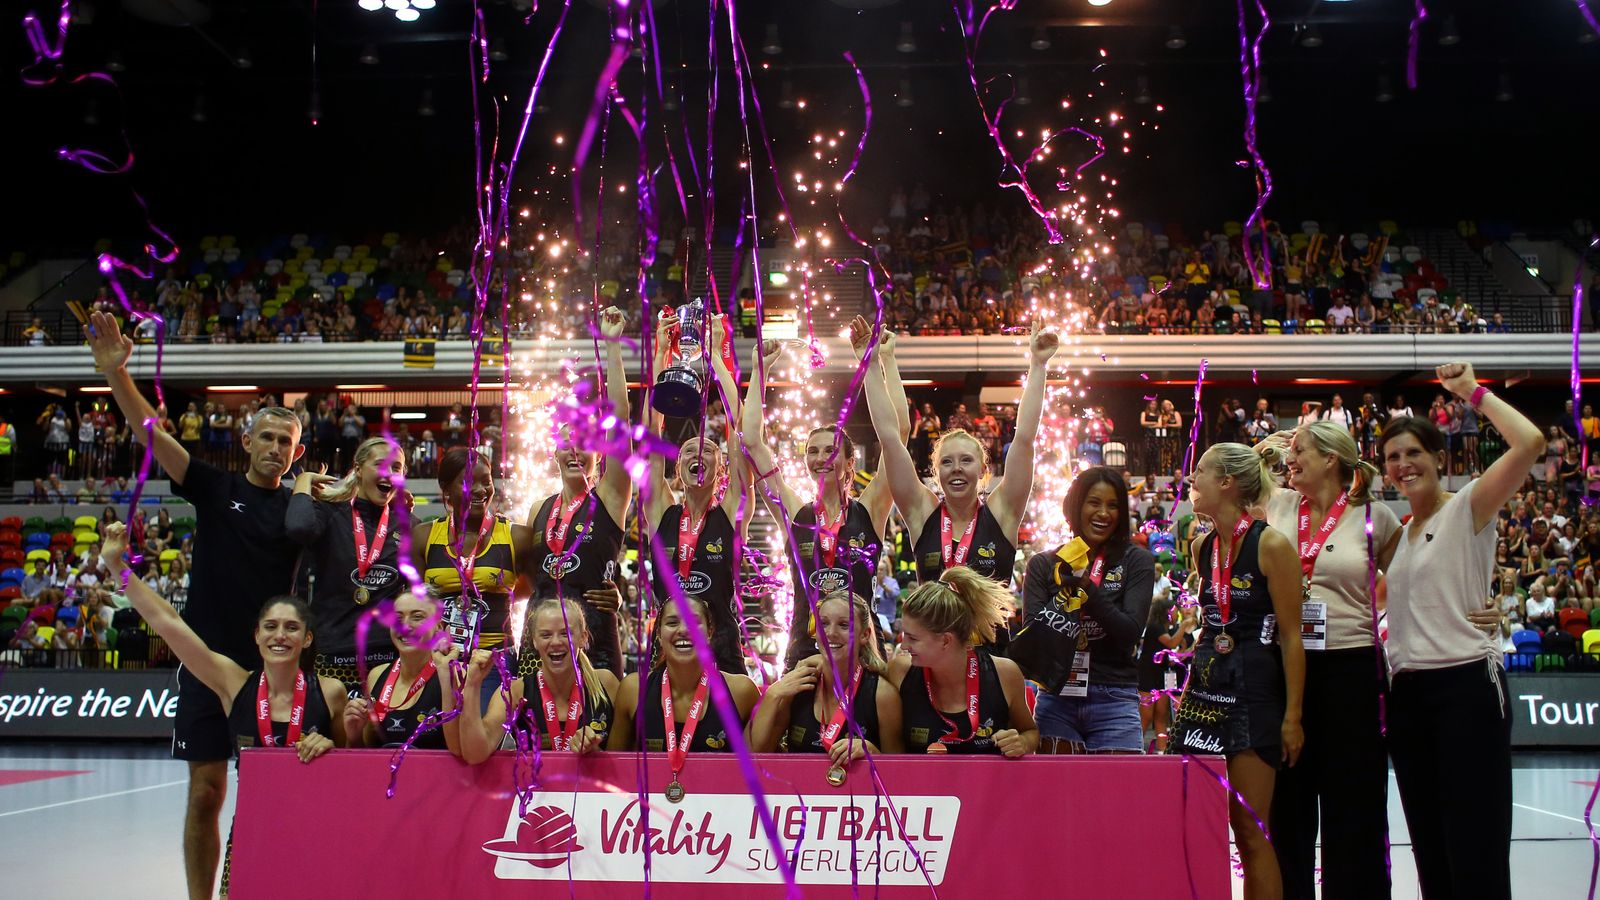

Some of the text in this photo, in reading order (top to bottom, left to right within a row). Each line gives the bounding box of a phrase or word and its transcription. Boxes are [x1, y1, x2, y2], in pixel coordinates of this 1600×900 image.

[366, 570, 387, 578] AND
[78, 687, 131, 718] the
[135, 688, 179, 718] Ne
[1518, 694, 1600, 725] Tour
[600, 798, 944, 875] Vitality NETBALL
